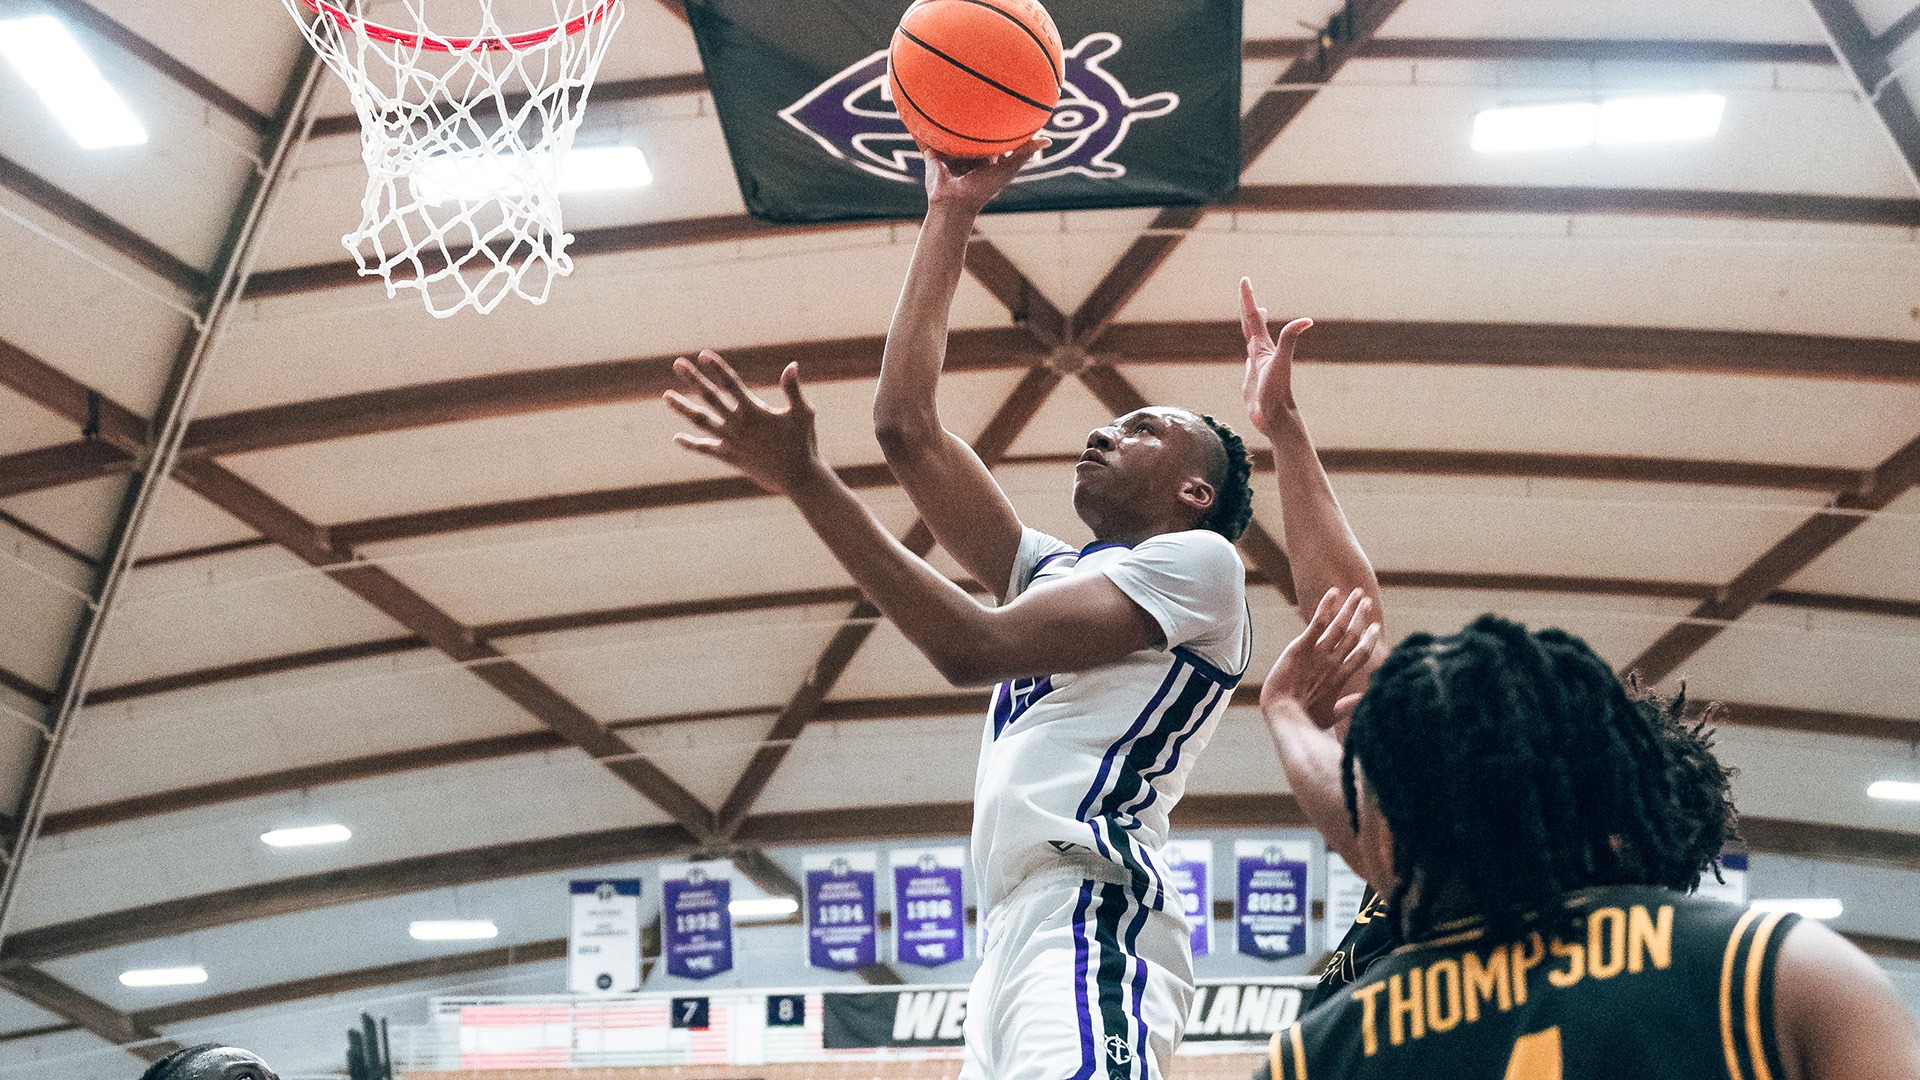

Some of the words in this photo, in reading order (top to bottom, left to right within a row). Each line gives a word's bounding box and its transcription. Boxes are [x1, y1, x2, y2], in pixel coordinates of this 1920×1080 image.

[819, 903, 864, 924] 1994
[1248, 892, 1297, 913] 2023
[1352, 905, 1675, 1057] THOMPSON
[682, 1000, 699, 1024] 7
[778, 998, 794, 1021] 8
